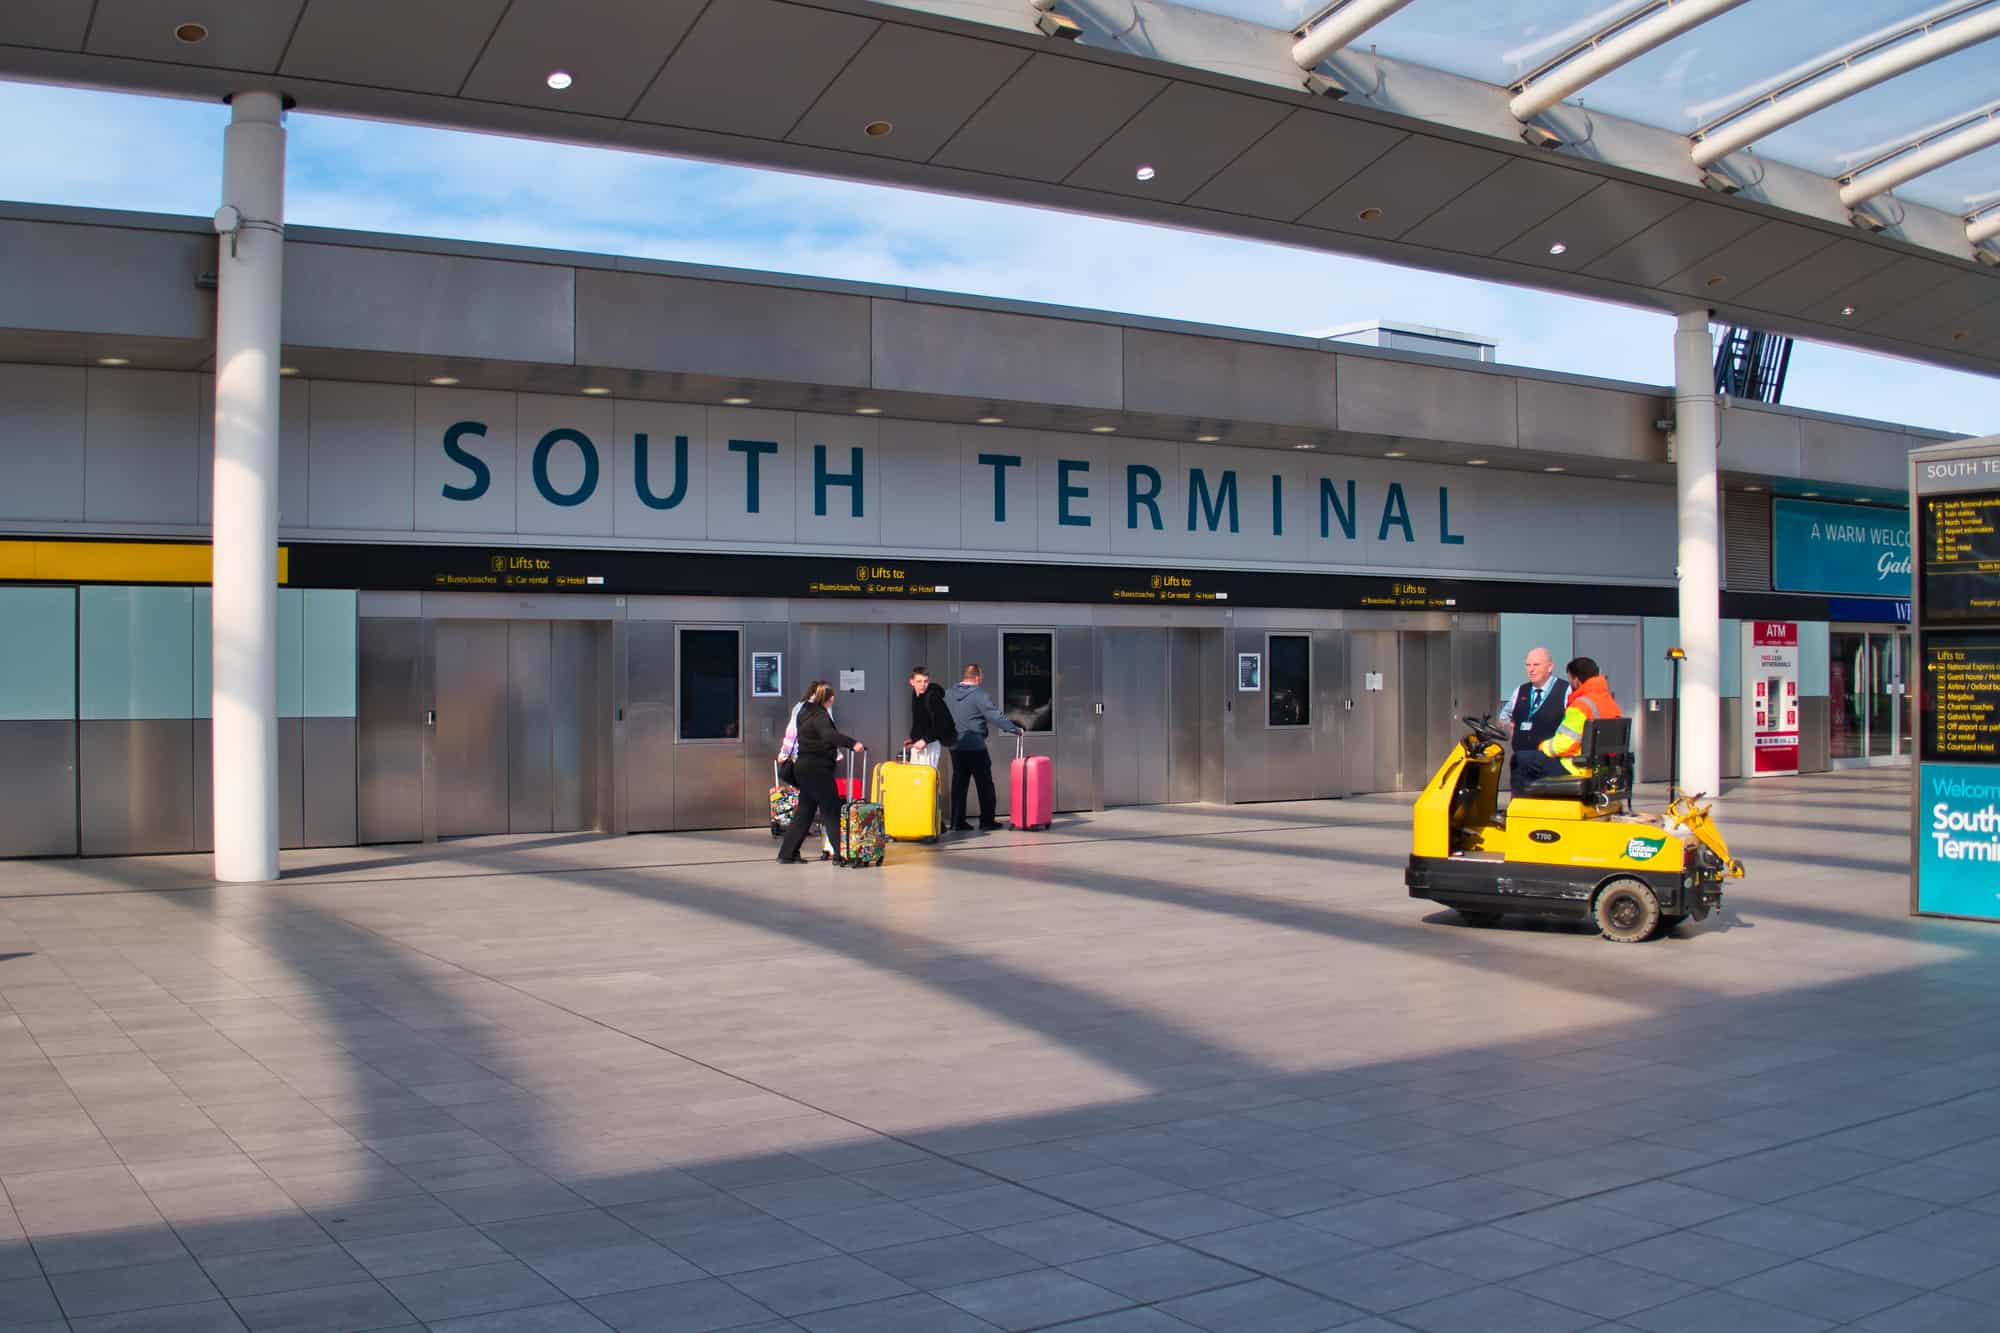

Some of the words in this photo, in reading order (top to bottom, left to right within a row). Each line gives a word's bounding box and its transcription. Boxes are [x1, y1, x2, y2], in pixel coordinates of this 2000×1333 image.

[1927, 463, 1977, 479] SOUTH
[442, 421, 864, 517] SOUTH
[978, 454, 1465, 545] TERMINAL
[1811, 523, 1820, 539] A
[1825, 523, 1865, 543] WARM
[510, 557, 533, 569] Lifts
[536, 559, 550, 569] to:
[871, 567, 891, 579] Lifts
[893, 569, 905, 579] to:
[1163, 575, 1180, 587] Lifts
[1181, 577, 1192, 587] to:
[1402, 584, 1417, 594] Lifts
[1766, 623, 1786, 637] ATM
[1937, 650, 1953, 660] Lifts
[1933, 802, 2000, 832] South
